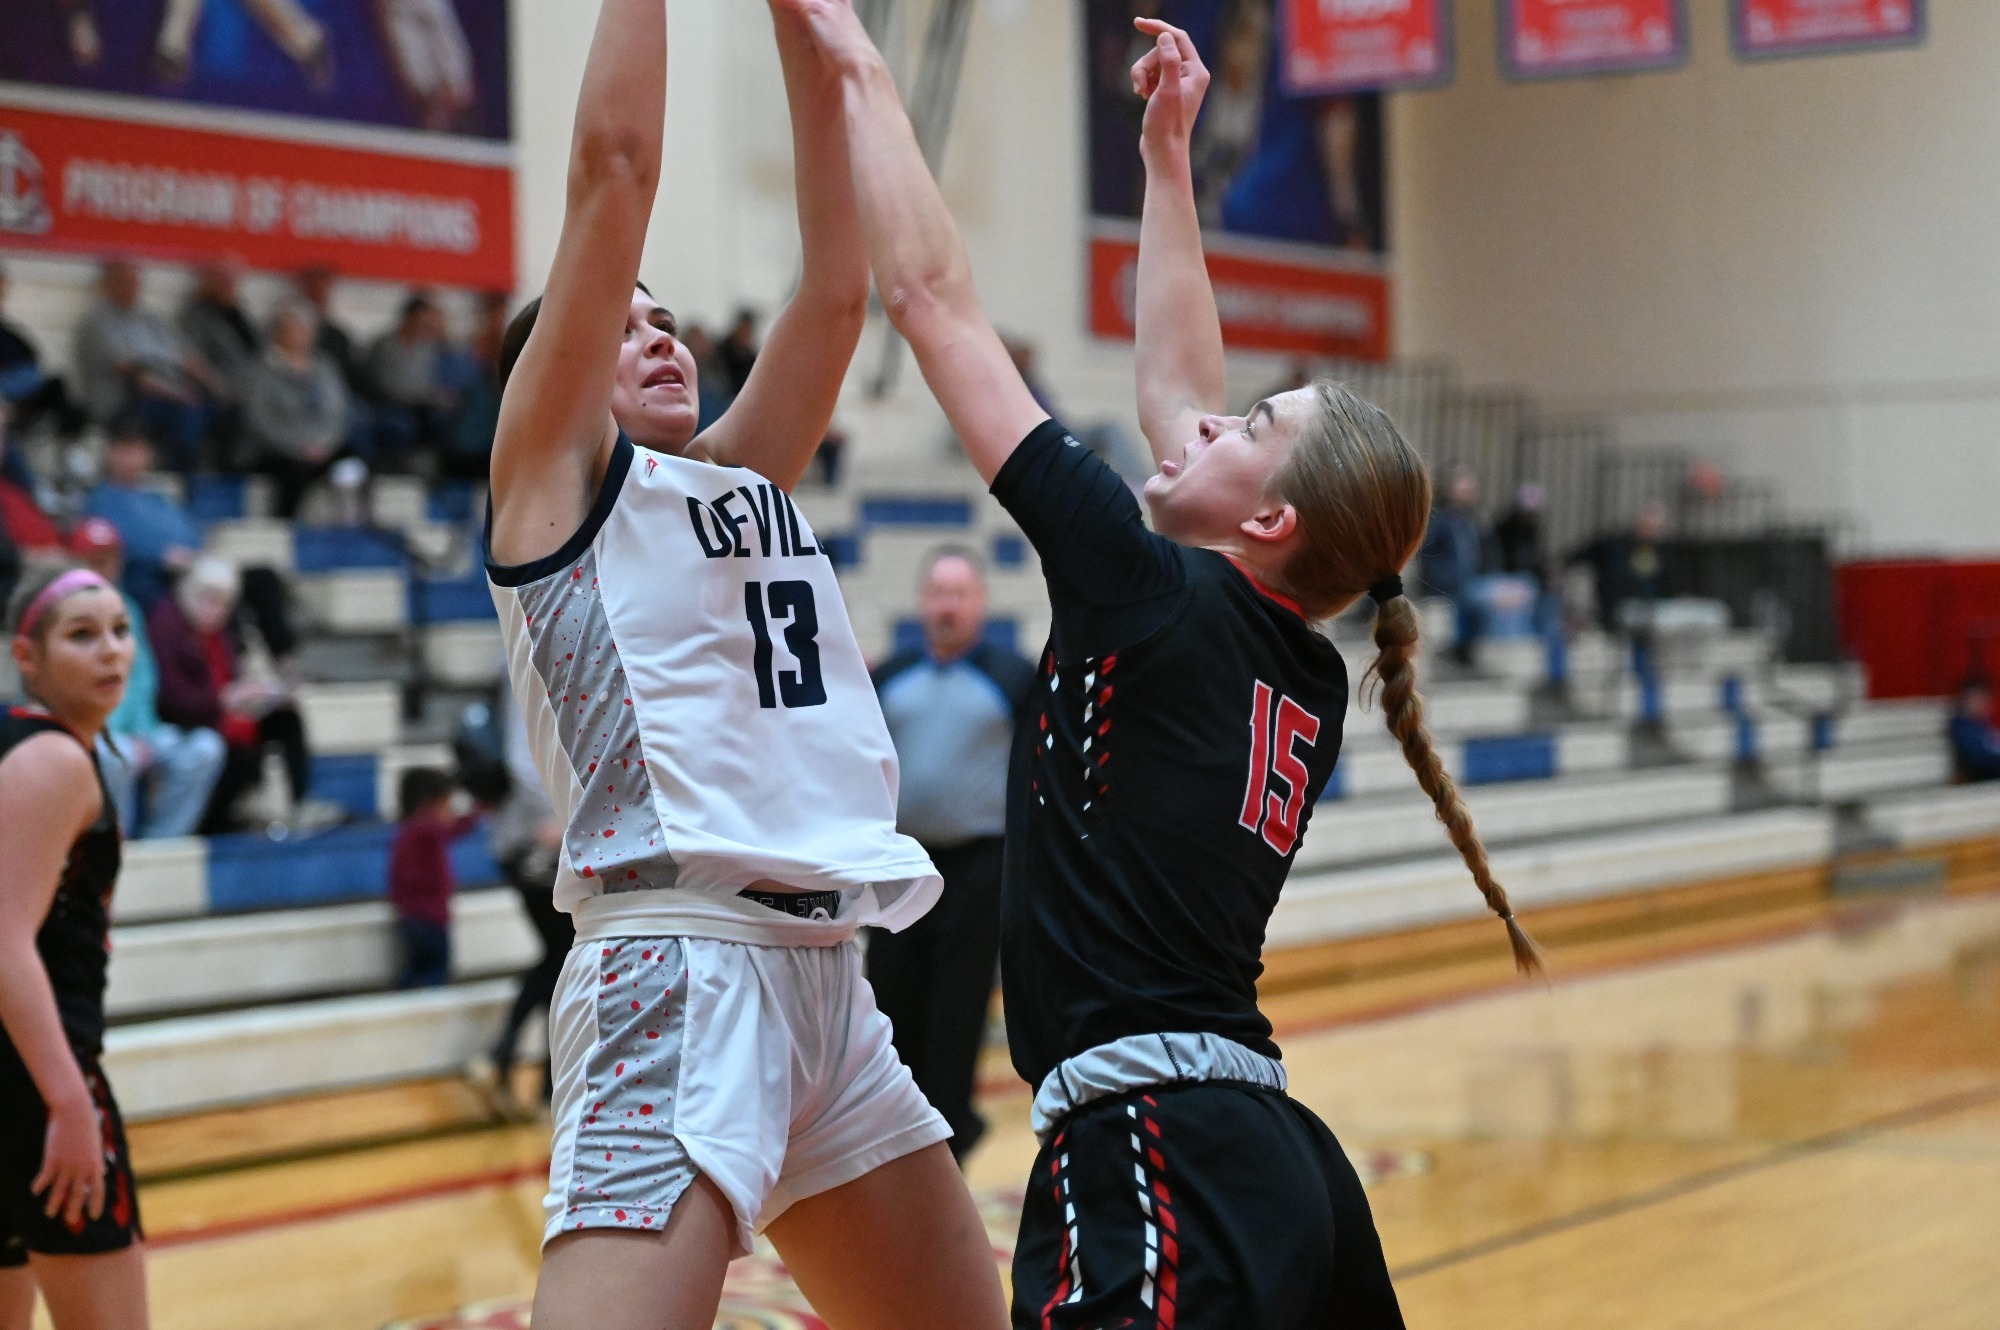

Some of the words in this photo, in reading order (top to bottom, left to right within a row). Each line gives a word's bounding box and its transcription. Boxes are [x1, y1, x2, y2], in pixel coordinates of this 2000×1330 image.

[64, 158, 237, 231] PROGRAM
[245, 176, 283, 234] OF
[289, 183, 479, 254] CHAMPIONS
[686, 484, 828, 558] DEVIL
[745, 580, 828, 709] 13
[1238, 678, 1320, 857] 15
